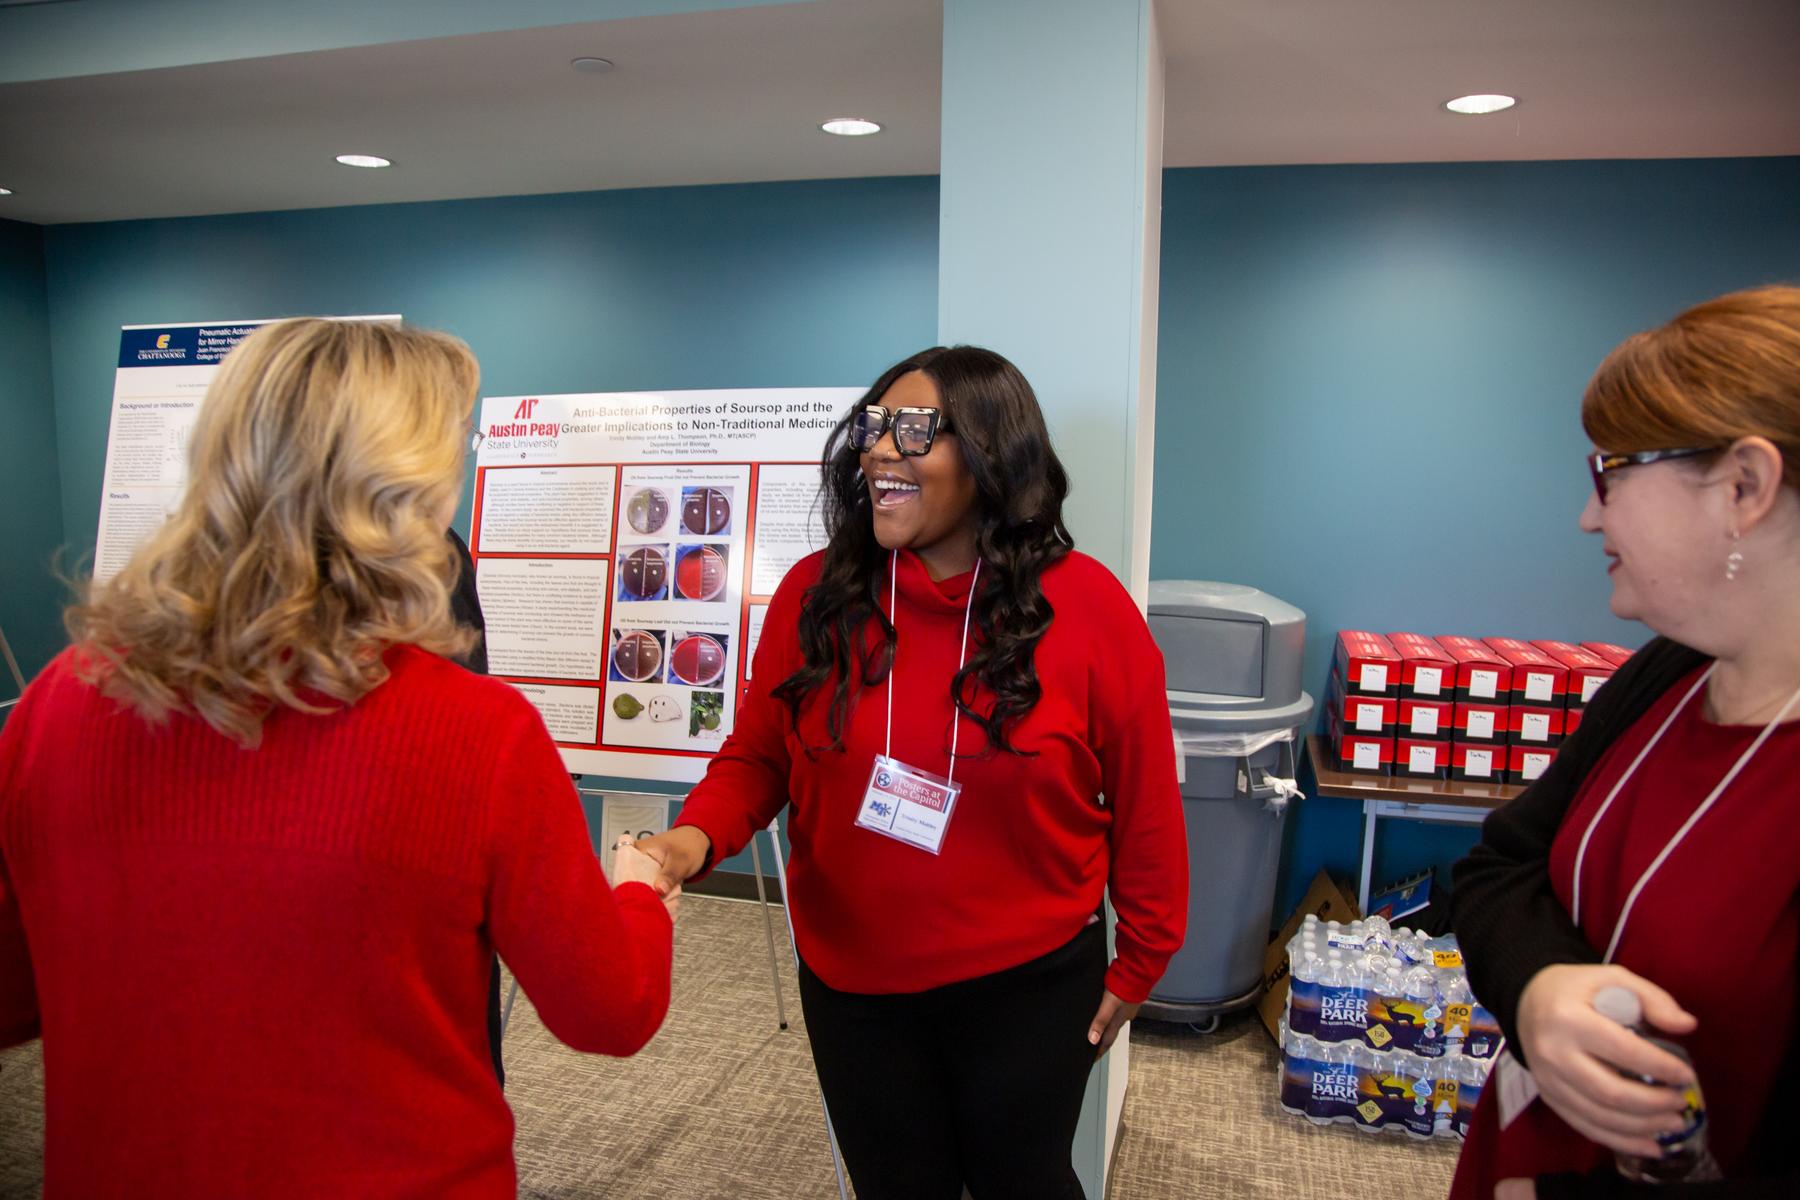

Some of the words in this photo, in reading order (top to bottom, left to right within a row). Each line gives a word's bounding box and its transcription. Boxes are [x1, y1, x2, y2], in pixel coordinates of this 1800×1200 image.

[138, 352, 186, 360] CHATTANOOGA
[573, 406, 648, 418] Anti-Bacterial
[652, 404, 711, 416] Properties
[715, 403, 727, 413] of
[730, 403, 782, 415] Soursop
[786, 402, 809, 413] and
[813, 402, 833, 412] the
[489, 424, 527, 438] Austin
[530, 423, 561, 438] Peay
[561, 423, 602, 434] Greater
[604, 421, 673, 434] Implications
[677, 420, 688, 430] to
[692, 418, 784, 430] Non-Traditional
[788, 417, 838, 429] Medicin
[487, 440, 511, 450] State
[513, 438, 559, 449] University
[899, 778, 930, 796] Posters
[931, 789, 941, 799] at
[893, 785, 908, 796] the
[909, 790, 941, 809] Capitol
[1322, 996, 1368, 1011] DEER
[1450, 1007, 1469, 1016] 40
[1321, 1008, 1368, 1024] PARK
[1313, 1071, 1359, 1088] DEER
[1438, 1082, 1456, 1092] 40
[1312, 1082, 1359, 1100] PARK
